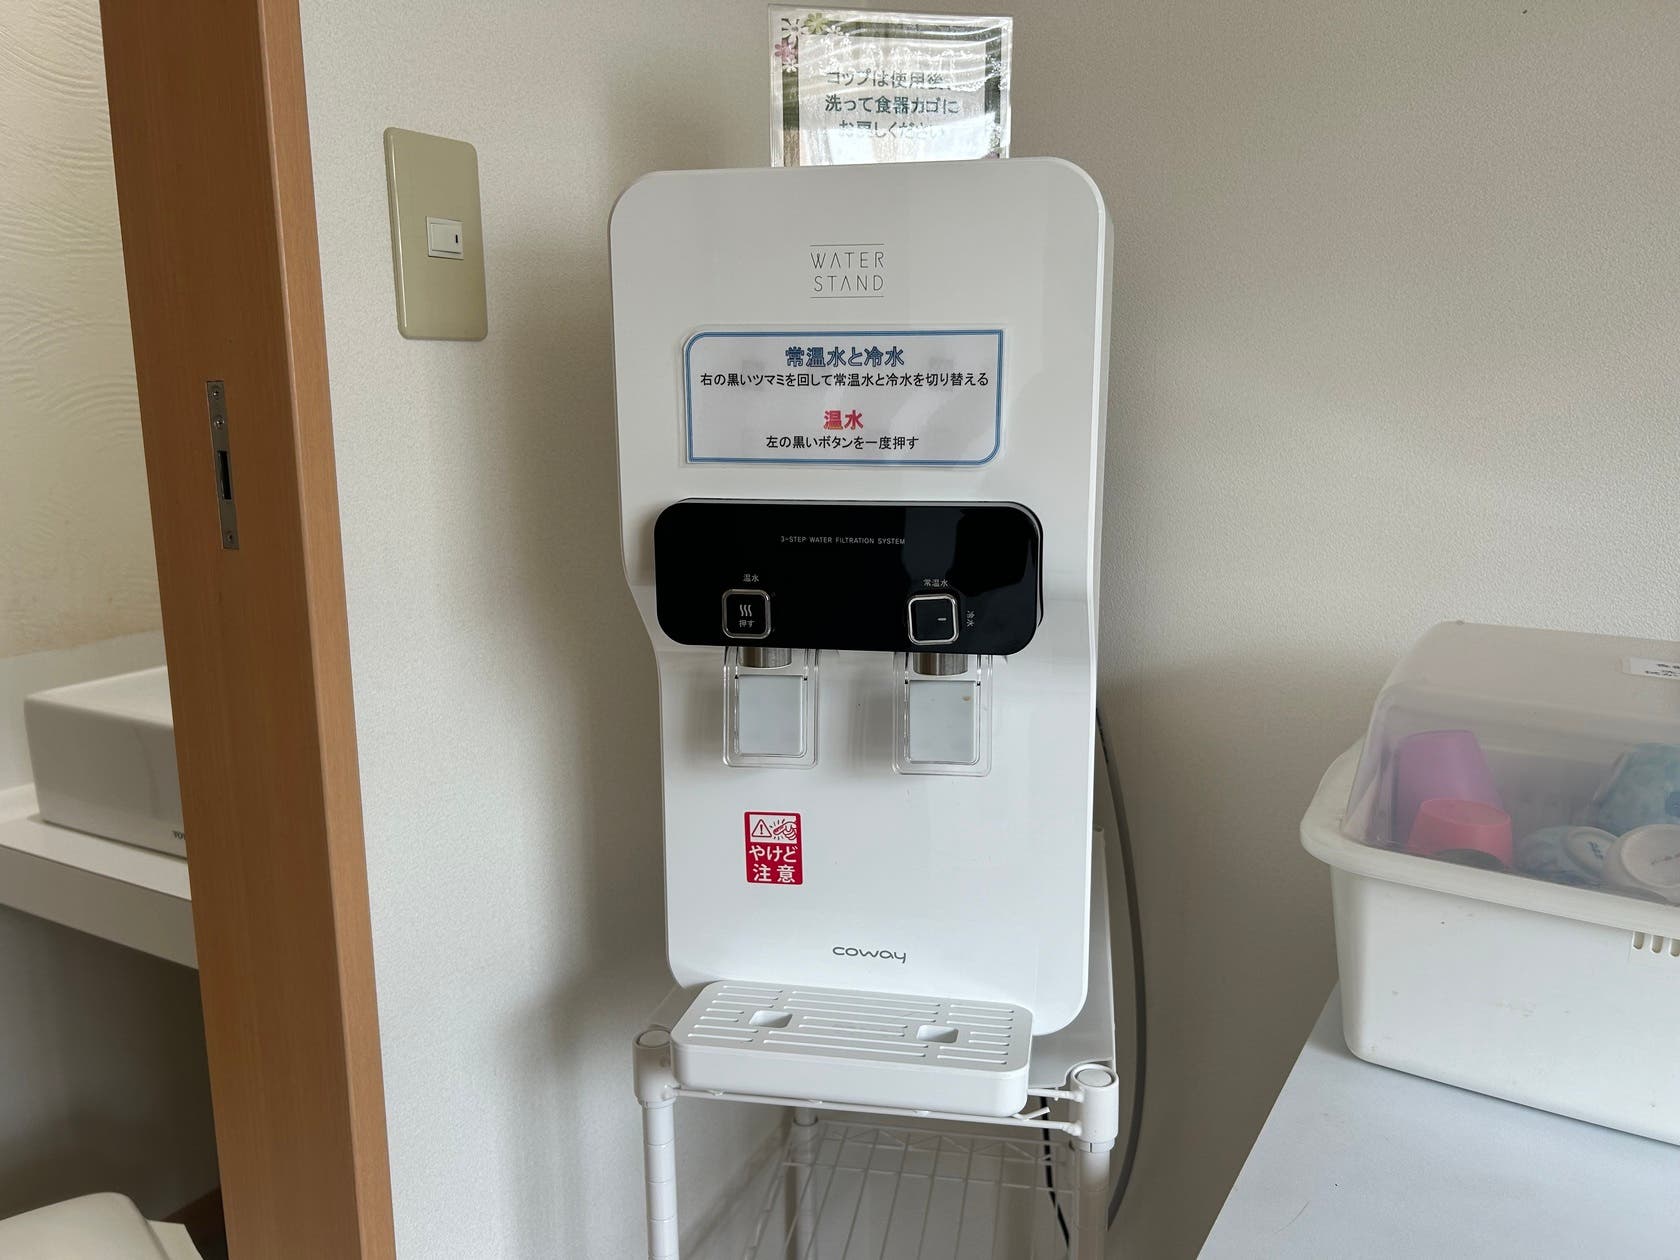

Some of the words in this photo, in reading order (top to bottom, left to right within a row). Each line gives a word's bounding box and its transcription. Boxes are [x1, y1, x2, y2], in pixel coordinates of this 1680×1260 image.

[824, 94, 961, 115] 洗って食器カゴに
[810, 251, 884, 269] WATER
[814, 274, 884, 292] STAND
[785, 346, 905, 368] 常温水と冷水
[700, 372, 990, 387] 右の黒いツマミを回して常温水と冷水を切り替える
[823, 410, 865, 431] 温水
[766, 436, 919, 450] 左の黒いボタンを一度押す
[780, 535, 806, 543] 3-STEP
[809, 536, 832, 544] WATER
[835, 536, 875, 545] FILTRATION
[877, 537, 906, 545] SYSTEM
[743, 573, 760, 583] 温水
[738, 619, 756, 628] 押す
[749, 845, 798, 863] やけど
[752, 864, 796, 883] 注意
[832, 946, 907, 963] coway
